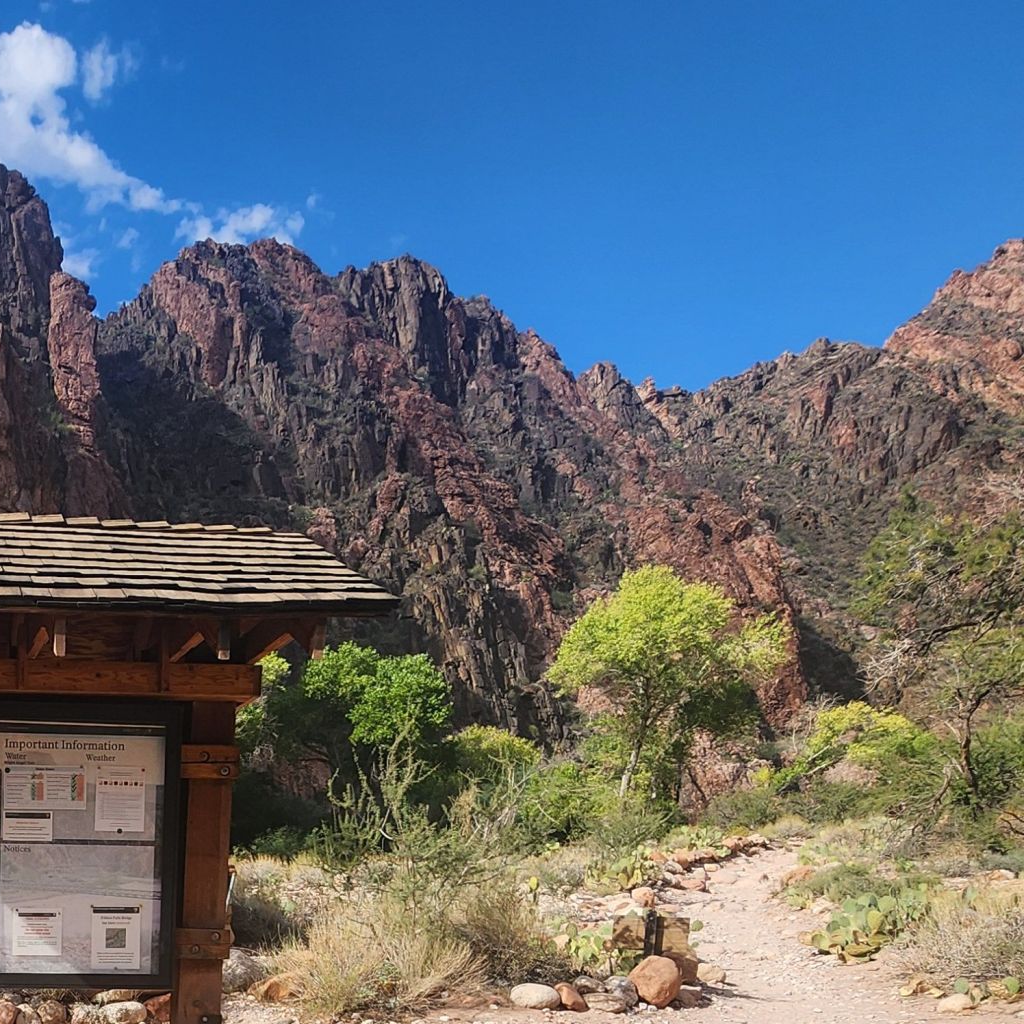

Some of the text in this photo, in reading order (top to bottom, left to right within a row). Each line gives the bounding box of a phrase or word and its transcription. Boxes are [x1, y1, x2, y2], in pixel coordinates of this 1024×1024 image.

[5, 739, 125, 751] Important Information
[6, 752, 26, 760] Water
[4, 845, 31, 853] Notices
